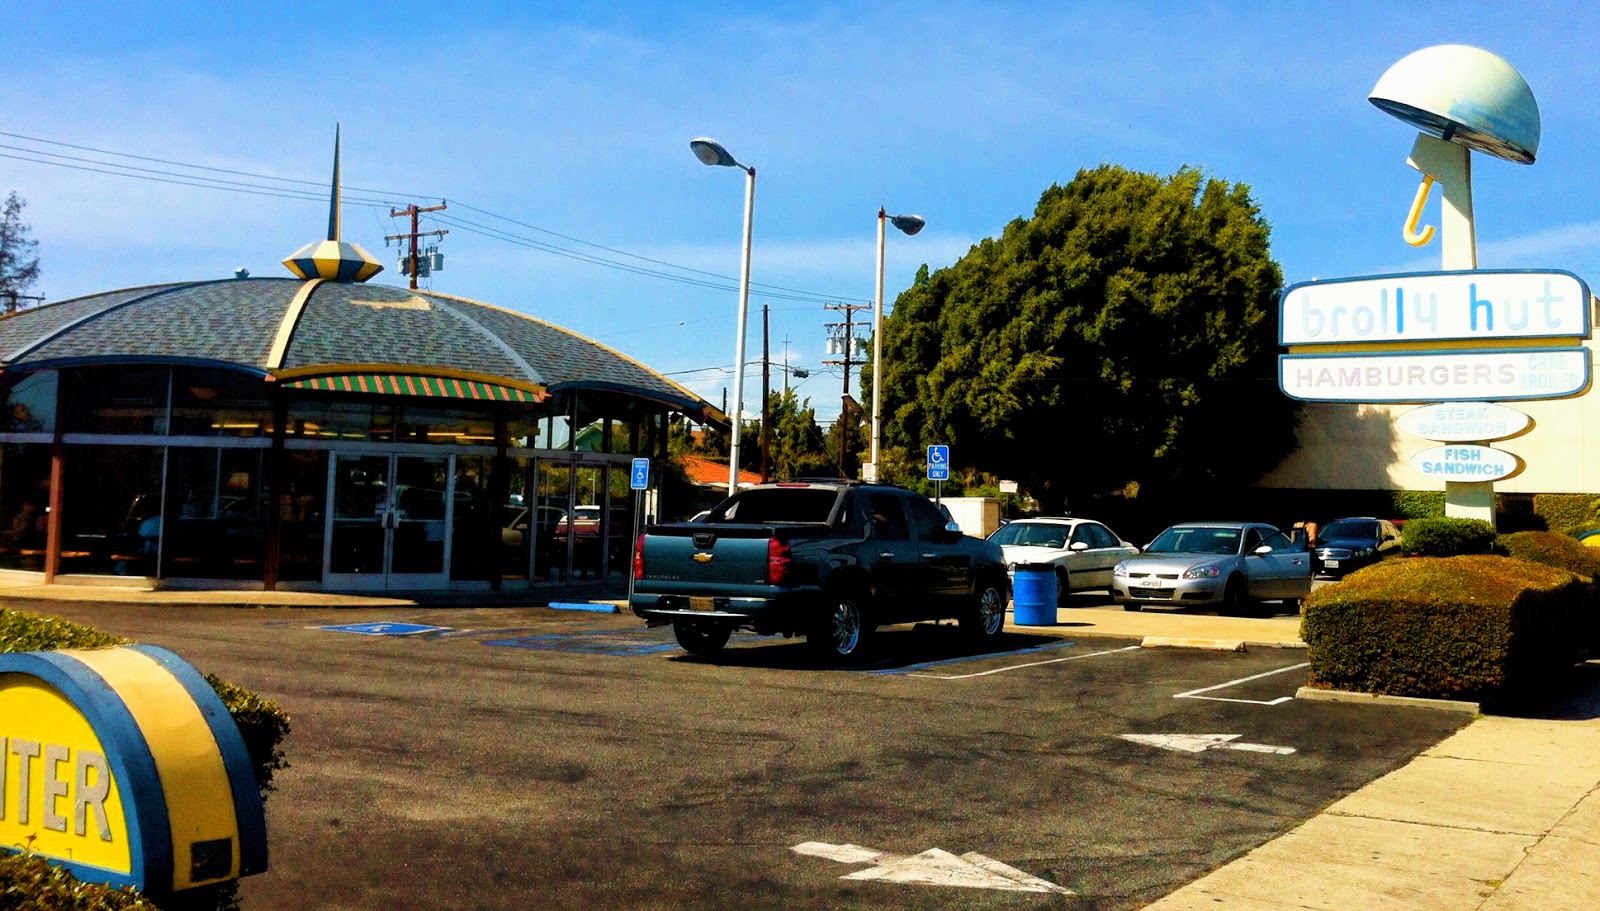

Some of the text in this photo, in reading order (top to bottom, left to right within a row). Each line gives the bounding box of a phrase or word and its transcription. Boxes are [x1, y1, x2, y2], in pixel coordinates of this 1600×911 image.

[1301, 278, 1564, 338] brolly hut
[1295, 363, 1516, 388] HAMBURGERS
[1433, 406, 1489, 421] STEAK
[1416, 420, 1507, 436] SANDWICH
[1444, 448, 1482, 461] FISH
[1421, 461, 1505, 476] SANDWICH
[0, 736, 112, 842] TER
